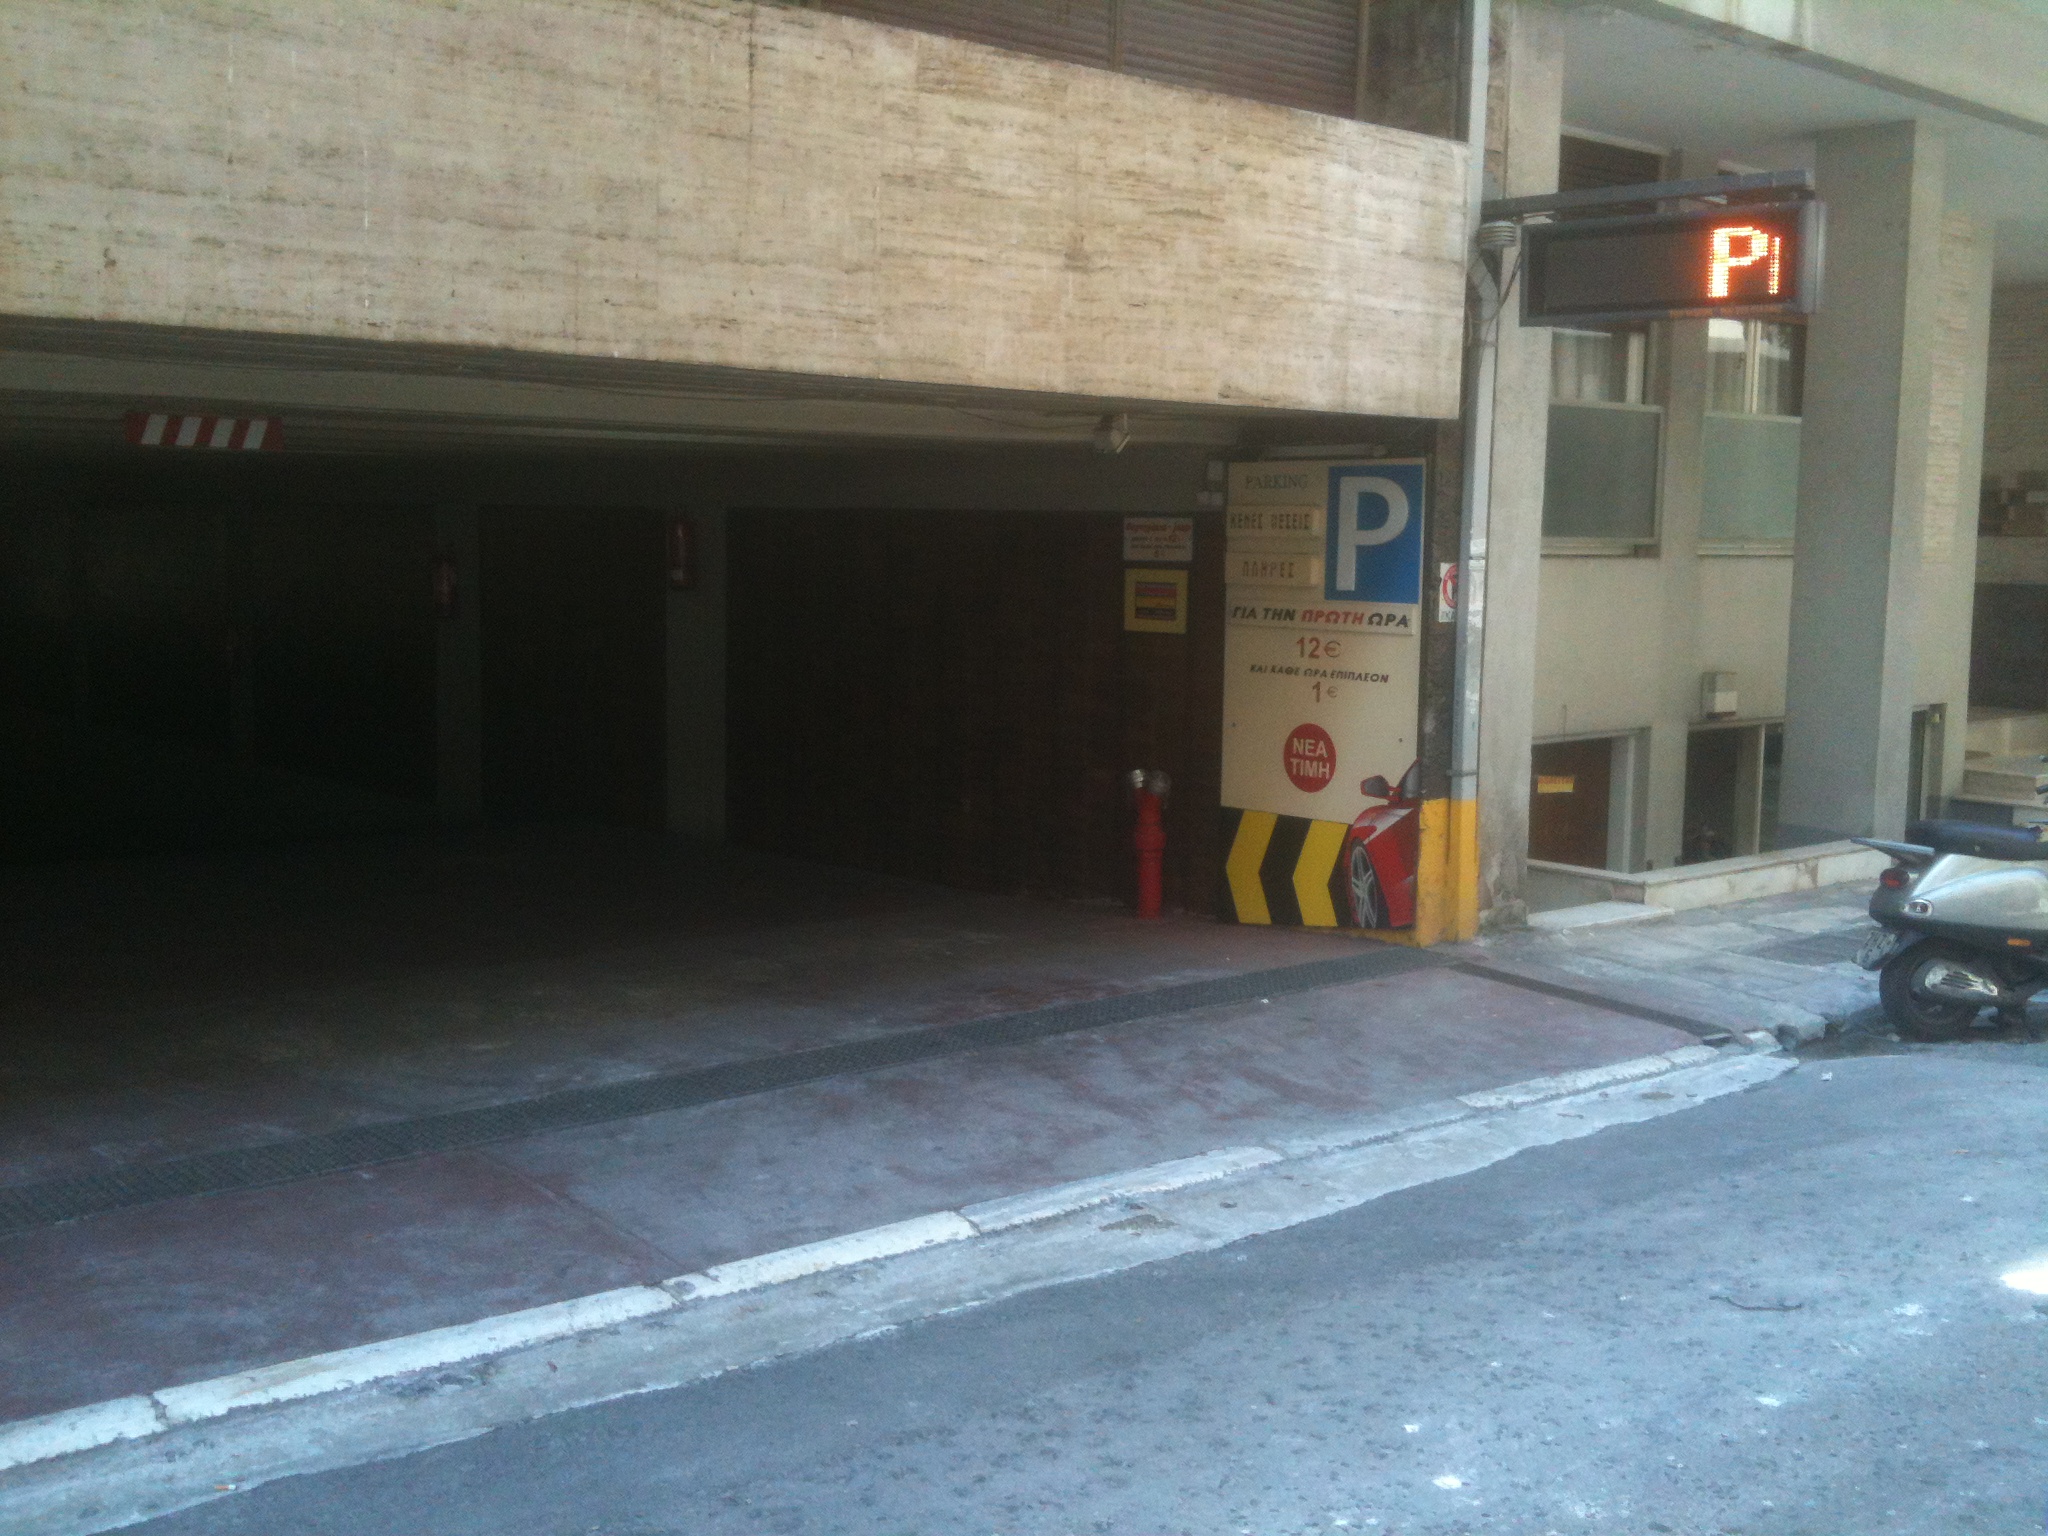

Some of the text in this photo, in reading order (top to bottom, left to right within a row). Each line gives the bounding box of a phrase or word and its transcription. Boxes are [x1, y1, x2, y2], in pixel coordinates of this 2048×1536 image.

[1245, 474, 1309, 489] PARKING
[1336, 476, 1409, 591] P
[1231, 606, 1410, 628] ΓΙΑ ΤΗΝ ΠΡΩΤΗ ΩΡΑ
[1297, 636, 1342, 659] 12€
[1292, 737, 1329, 758] ΝΕΑ
[1290, 758, 1331, 779] ΤΙΜΗ
